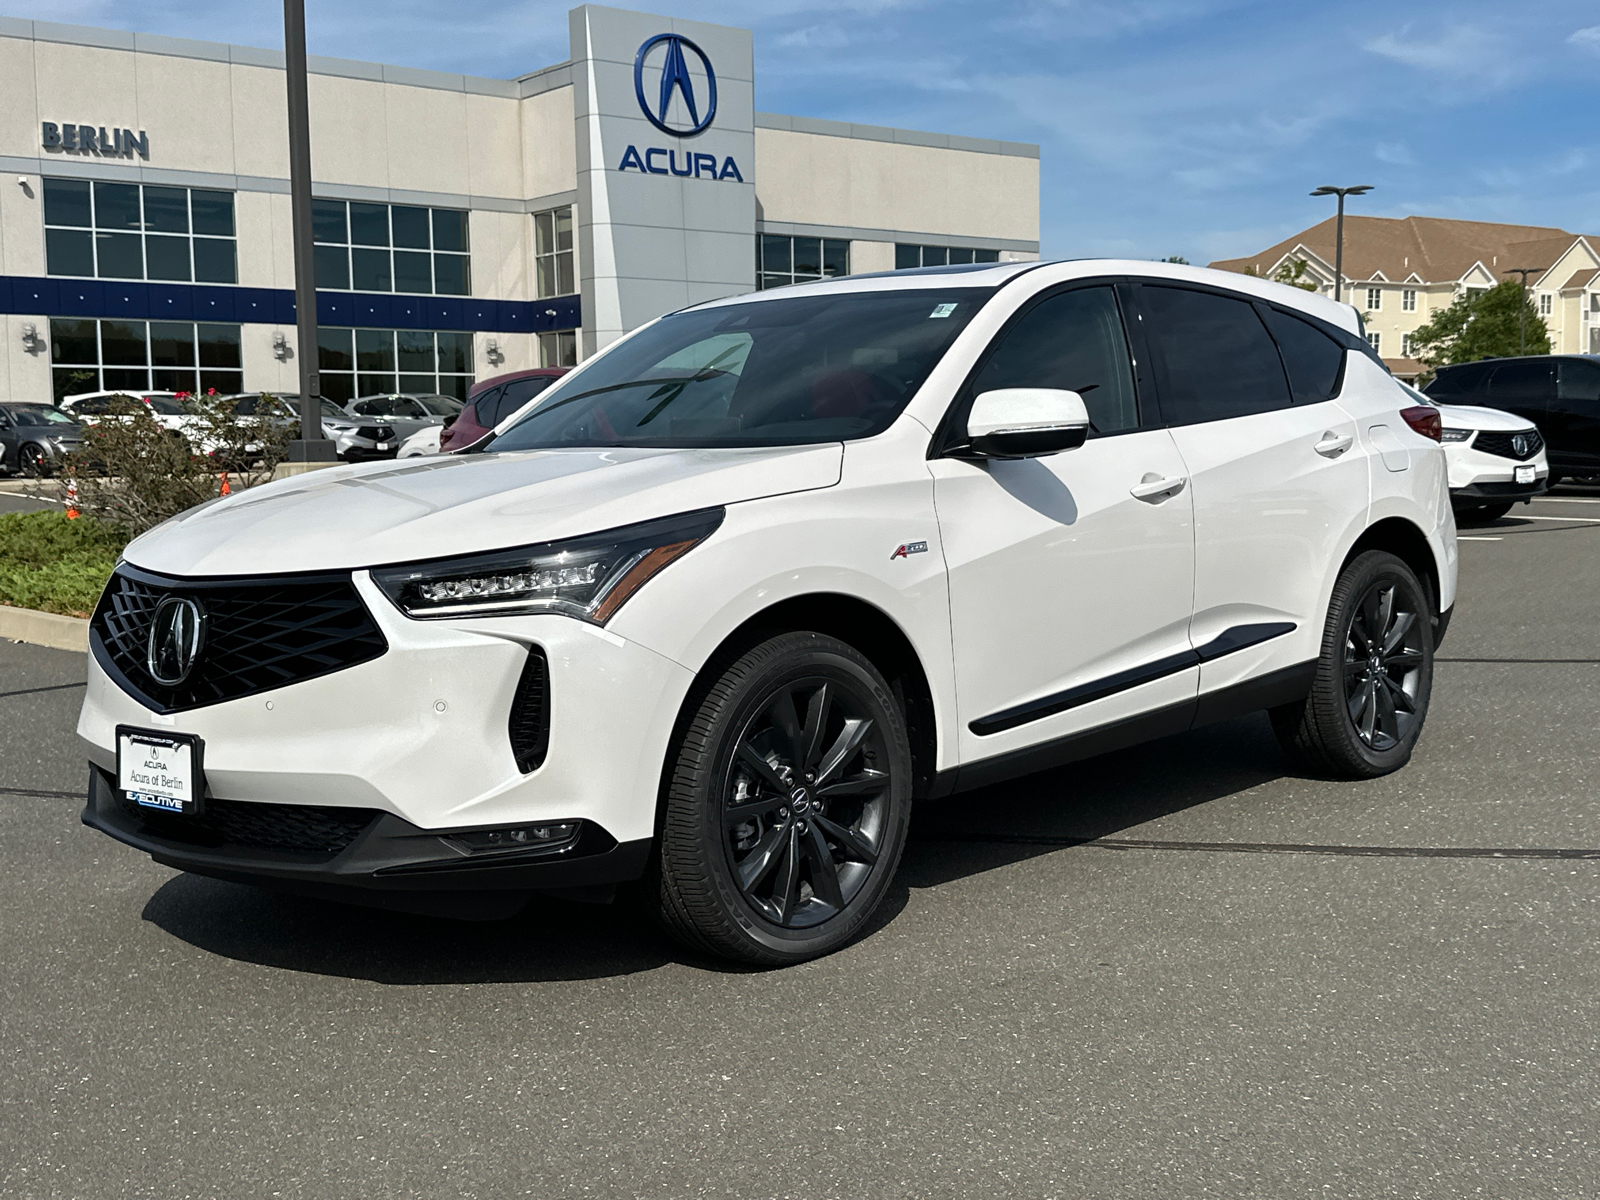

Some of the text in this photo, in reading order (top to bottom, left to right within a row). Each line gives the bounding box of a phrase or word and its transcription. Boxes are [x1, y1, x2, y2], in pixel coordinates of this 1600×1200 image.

[42, 121, 147, 155] BERLIN
[618, 145, 744, 183] ACURA
[143, 760, 168, 771] ACURA
[130, 769, 183, 790] Acura of Berlin
[126, 791, 183, 809] EXECUTIVE
